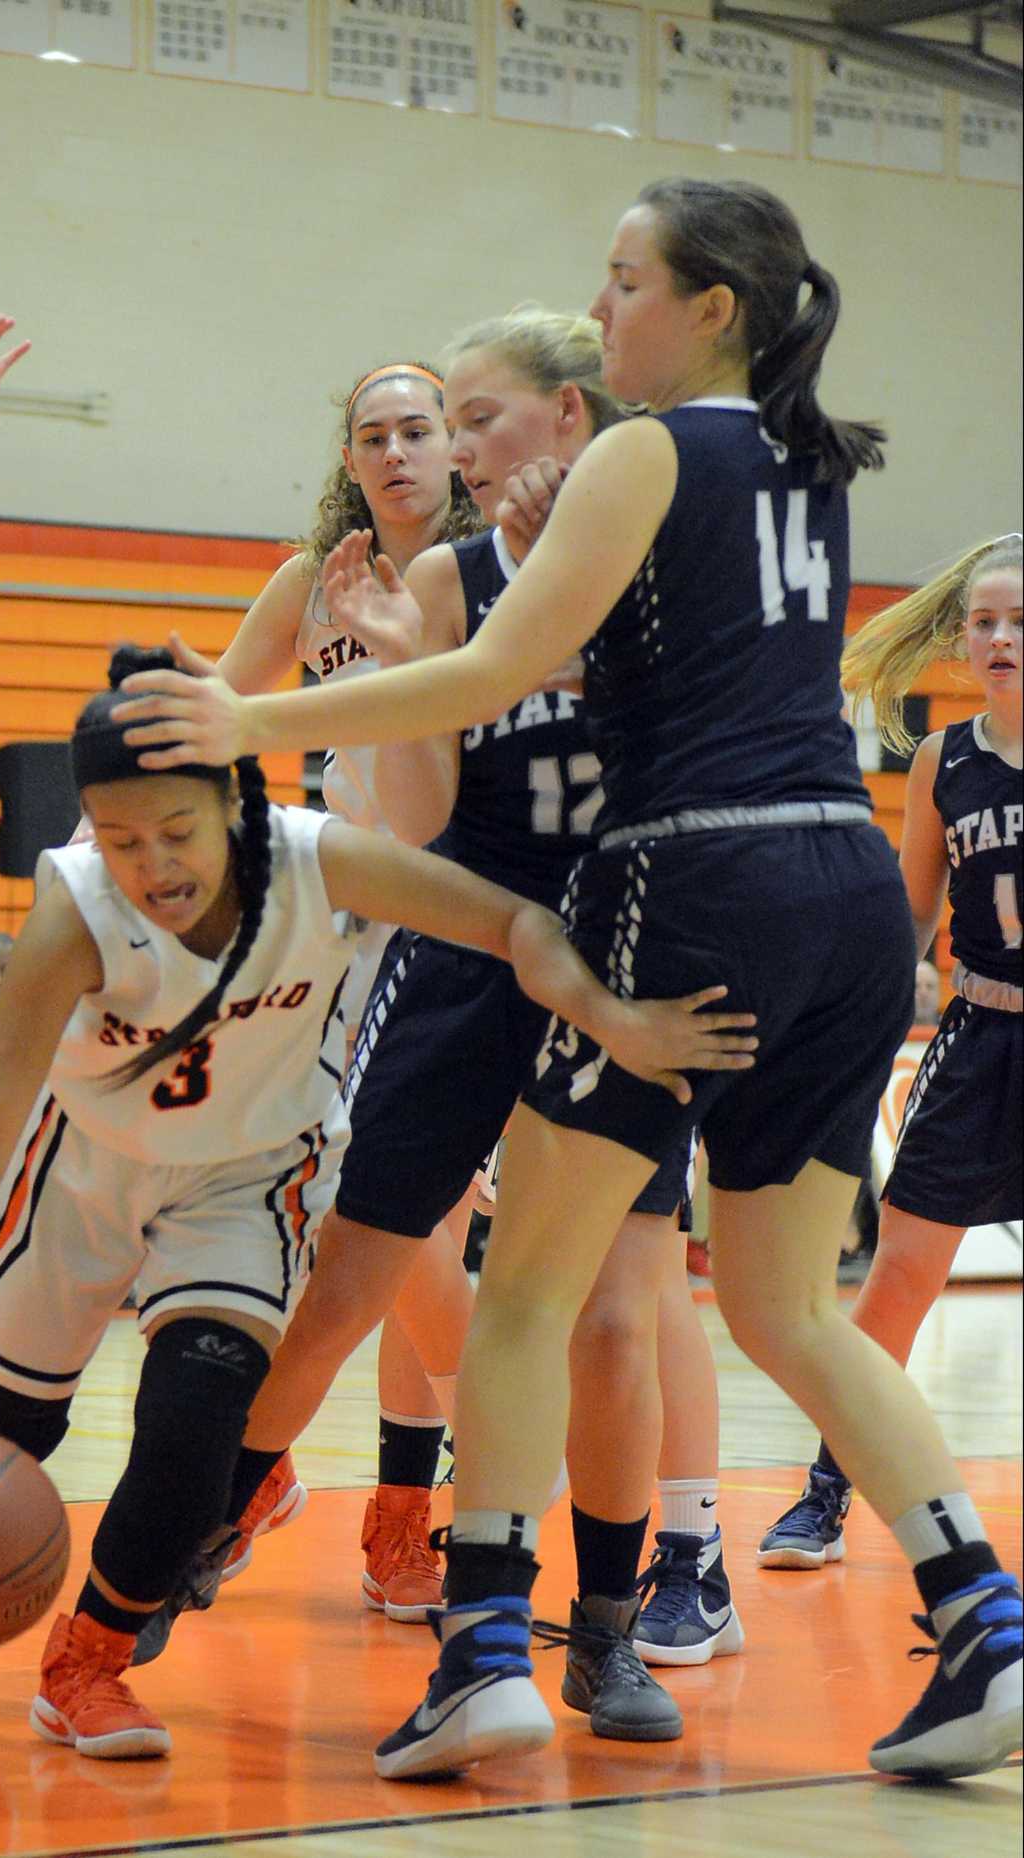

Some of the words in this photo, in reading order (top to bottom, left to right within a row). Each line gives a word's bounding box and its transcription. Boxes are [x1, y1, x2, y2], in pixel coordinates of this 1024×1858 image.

[534, 24, 630, 56] HOCKEY
[694, 48, 788, 77] SOCCER
[755, 488, 832, 627] 14
[319, 632, 374, 677] STA
[527, 751, 608, 836] 12
[150, 1032, 216, 1113] 3
